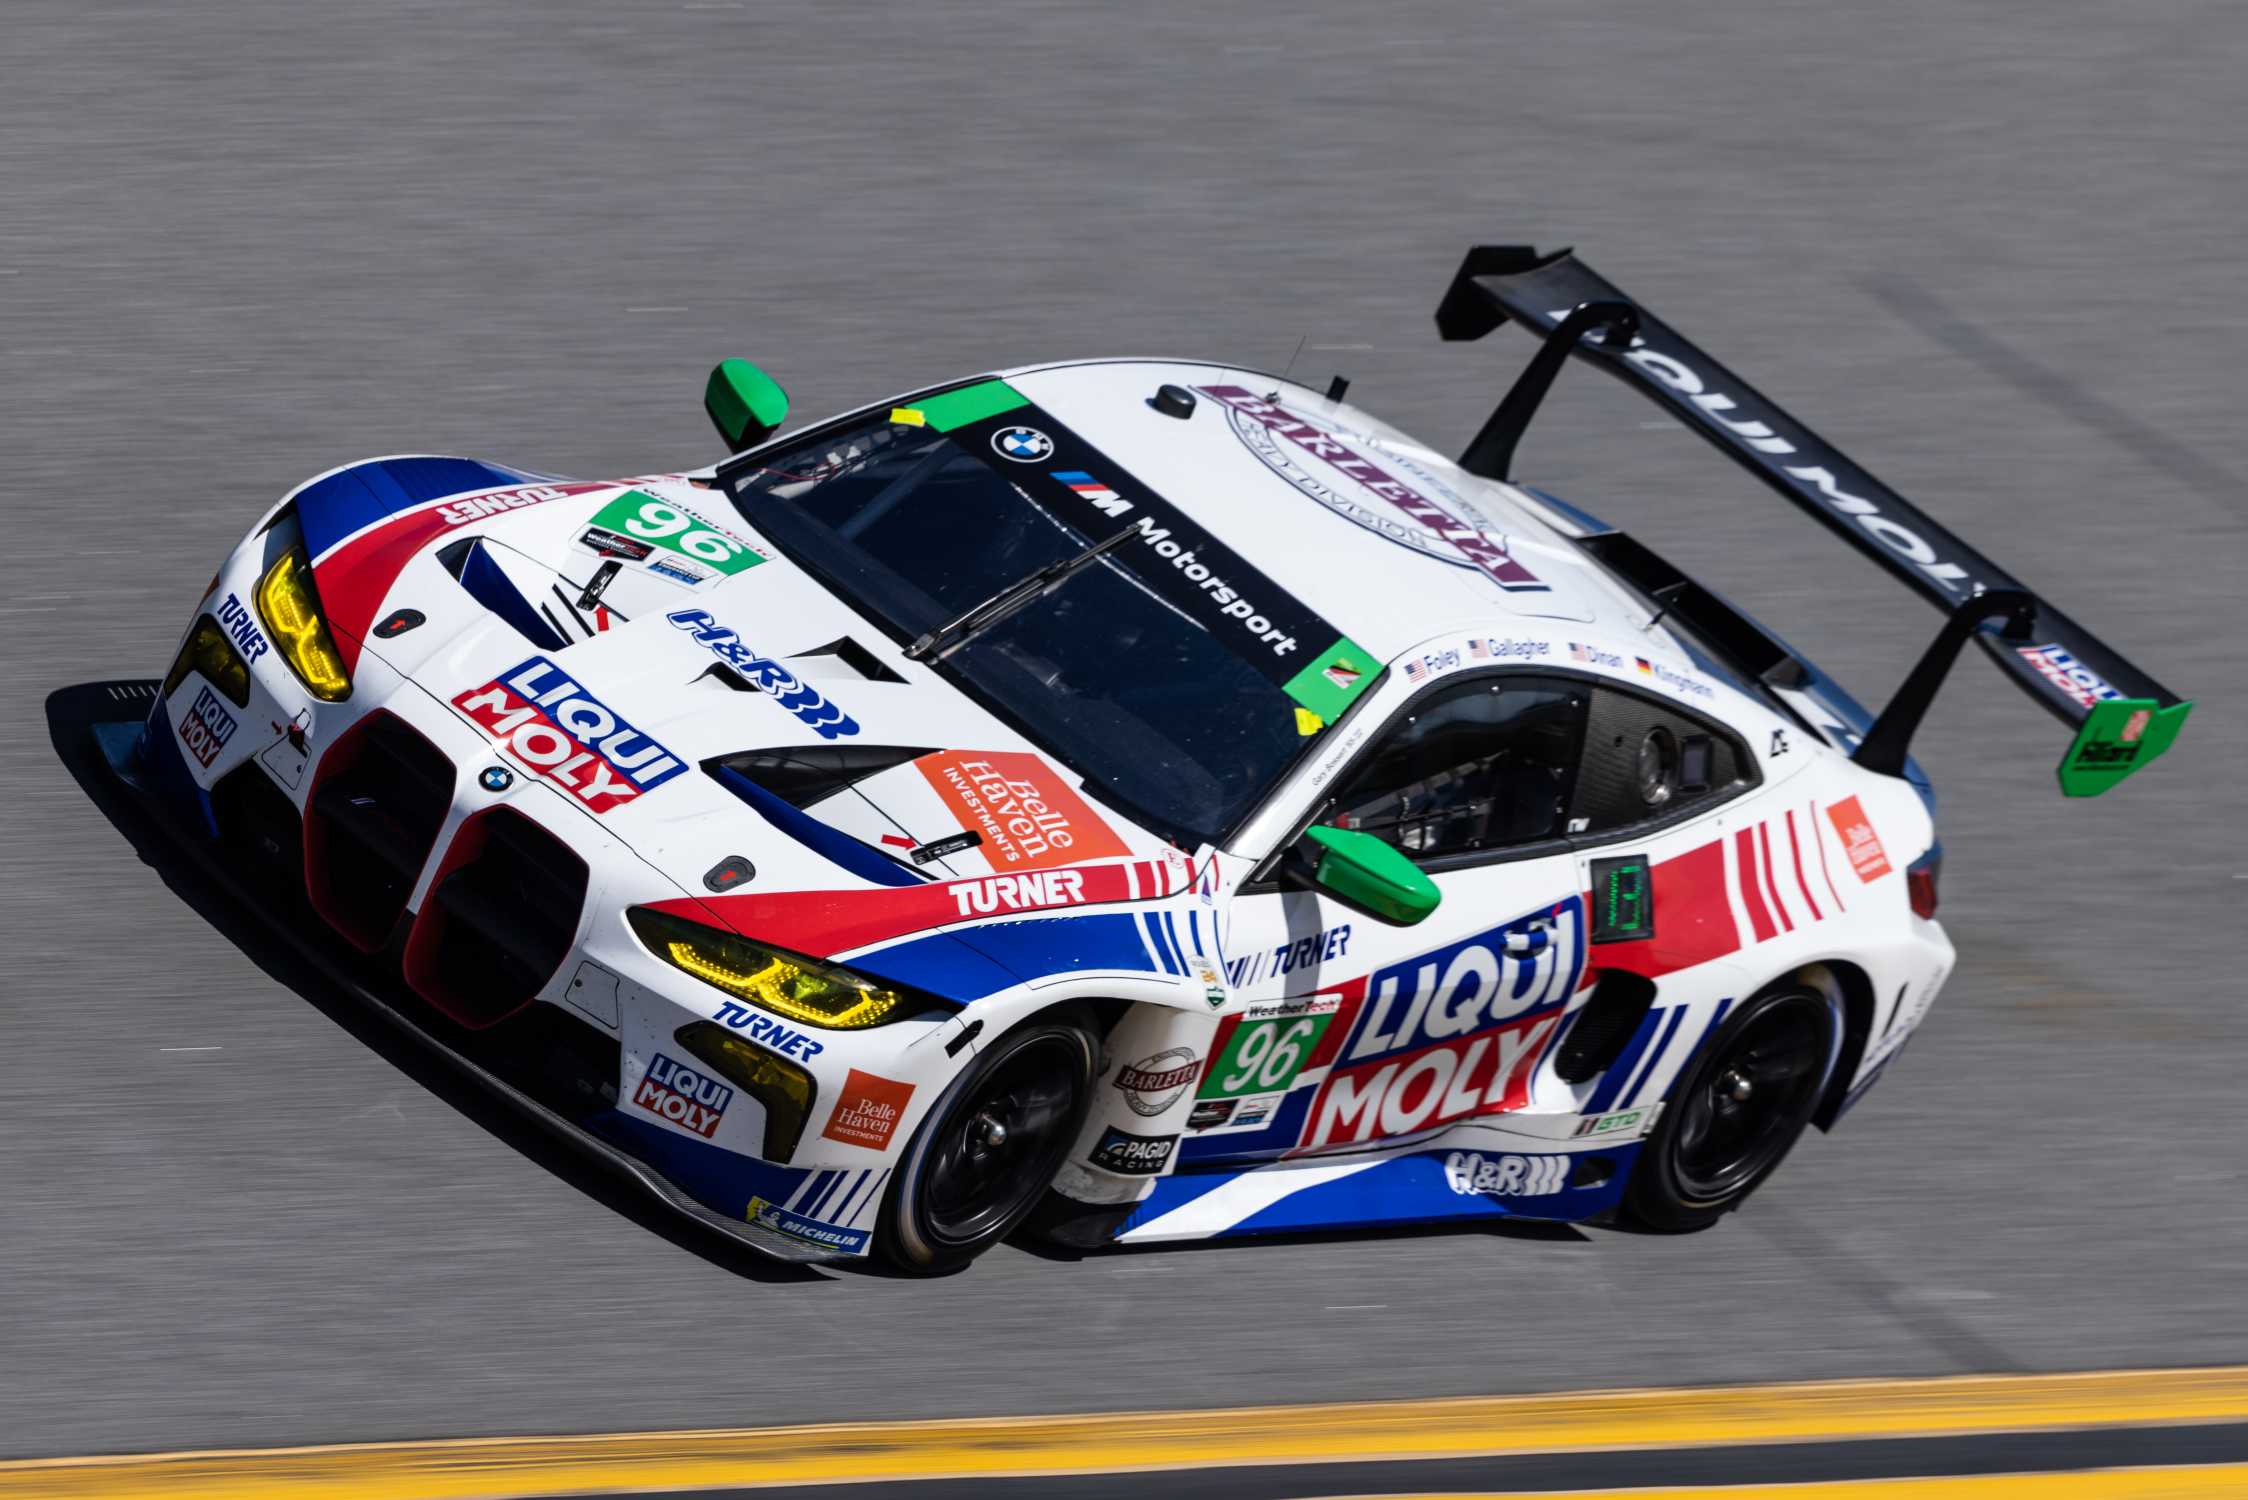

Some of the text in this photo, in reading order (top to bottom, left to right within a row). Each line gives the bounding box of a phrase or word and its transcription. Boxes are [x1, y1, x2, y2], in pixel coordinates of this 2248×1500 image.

[1546, 303, 1985, 601] QUI MOL
[436, 486, 568, 524] TURNER
[625, 503, 742, 562] 96
[1082, 489, 1297, 656] M Motorsport
[216, 593, 269, 664] TURNER
[1424, 649, 1460, 674] Foley
[2021, 652, 2096, 708] MOL
[2041, 649, 2128, 700] LIQU
[180, 719, 218, 767] MOLY
[194, 690, 234, 744] LIQUI
[461, 687, 636, 800] MOLY
[508, 658, 679, 784] LIQUI
[943, 767, 1020, 862] INVESTMENTS
[959, 760, 1047, 858] Haven
[1008, 778, 1074, 849] Belle
[948, 870, 1086, 916] TURNER
[1270, 924, 1351, 978] TURNER
[1249, 1001, 1336, 1017] WeatherTech
[1347, 909, 1575, 1061] LIQUI
[712, 1001, 824, 1063] TURNER
[1222, 1018, 1314, 1093] 96
[637, 1082, 721, 1133] MOLY
[651, 1056, 731, 1108] LIQUI
[1304, 1015, 1558, 1151] MOLY
[833, 1126, 884, 1143] INVESTMENTS
[837, 1108, 890, 1133] Haven
[857, 1098, 897, 1122] Belle
[1123, 1141, 1171, 1159] PAGID
[1445, 1152, 1527, 1195] H&R
[781, 1220, 860, 1246] MICHELIN
